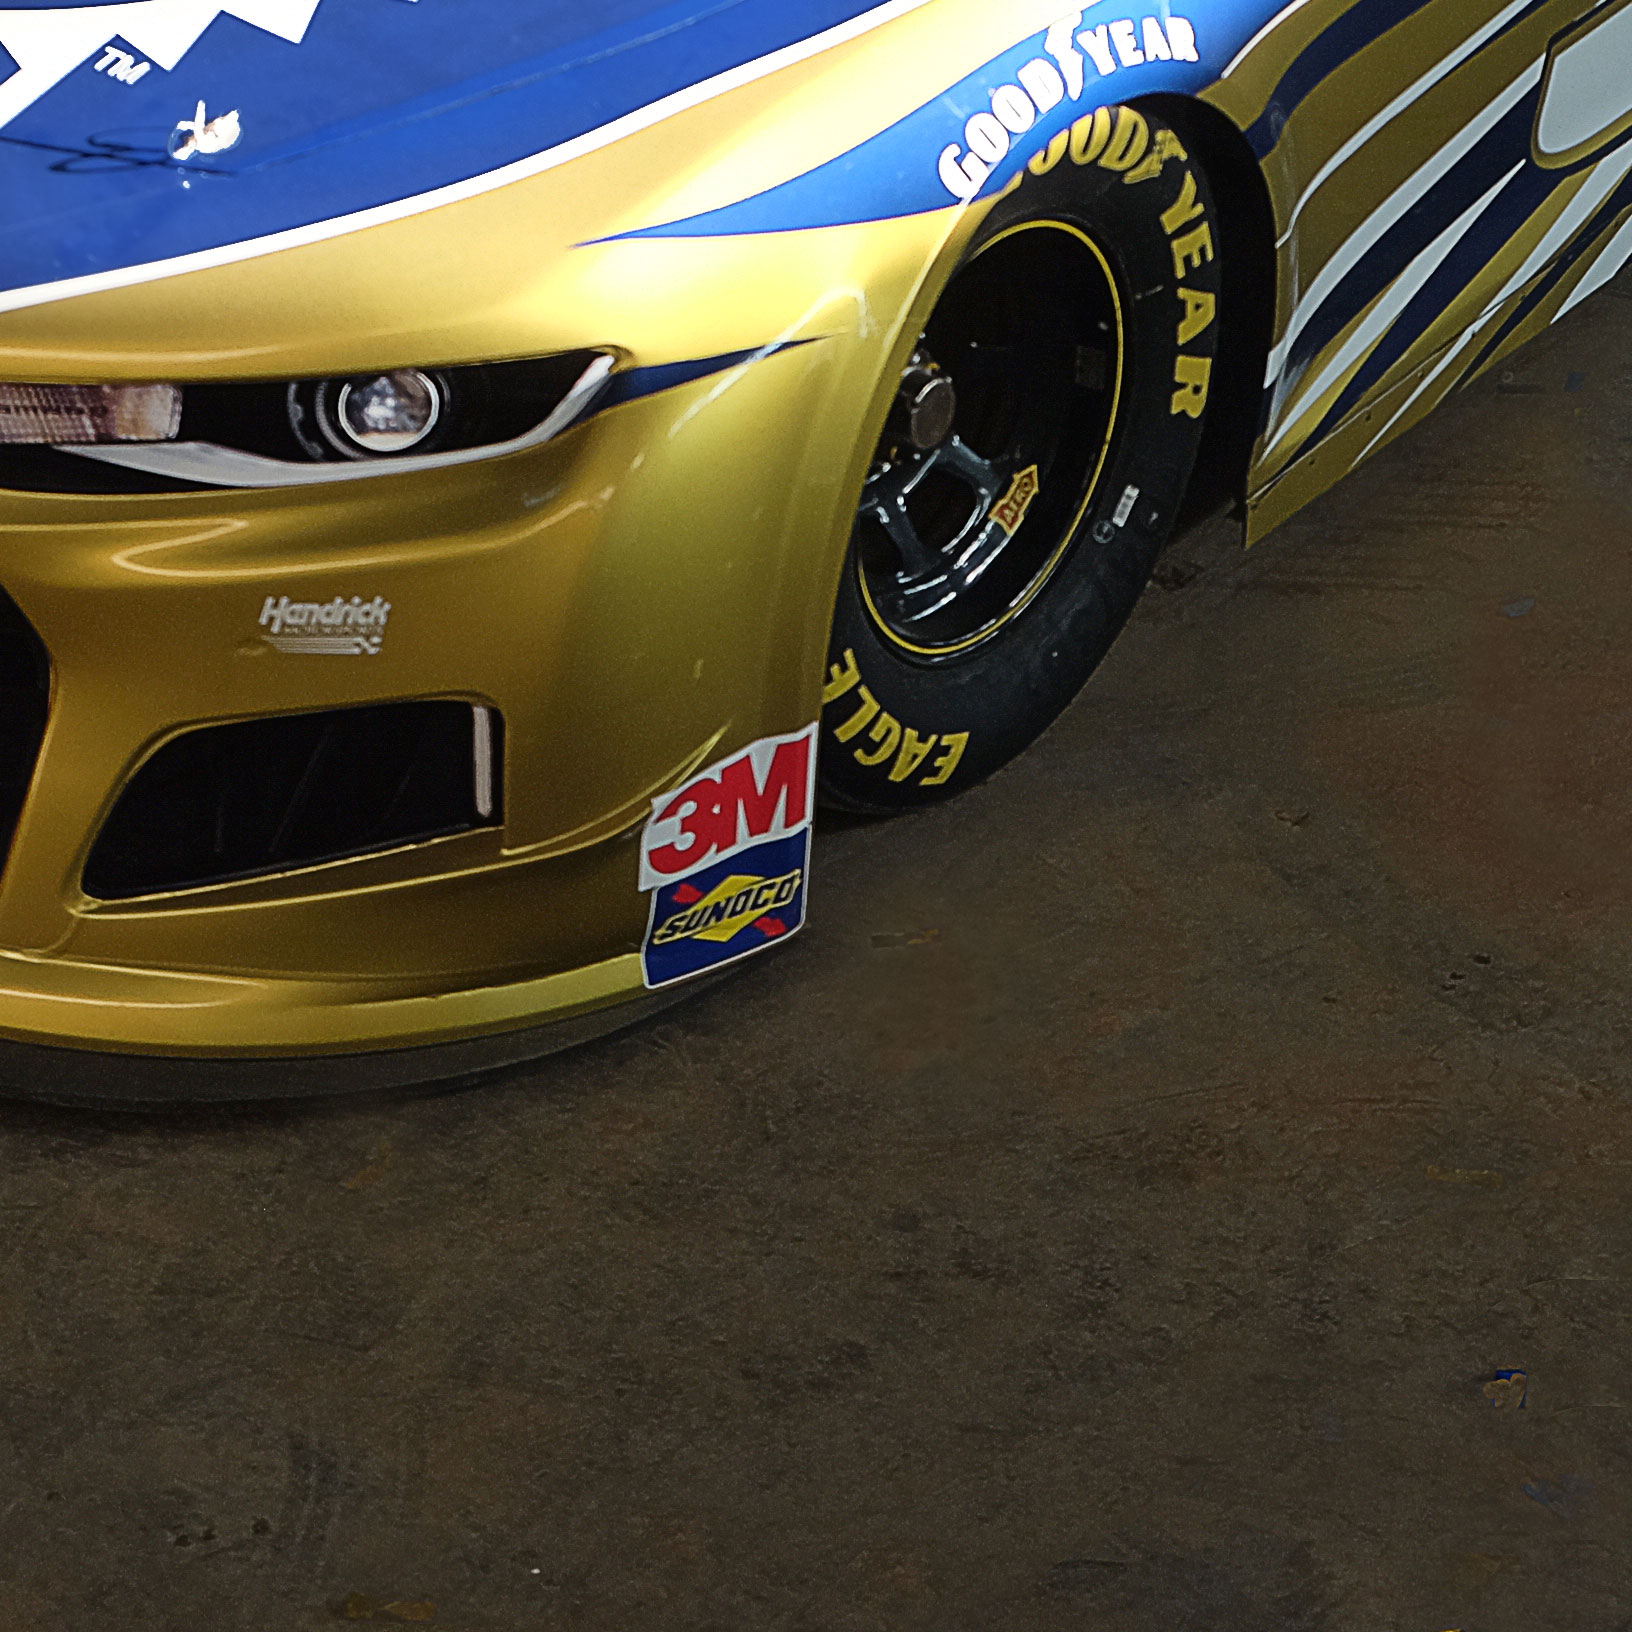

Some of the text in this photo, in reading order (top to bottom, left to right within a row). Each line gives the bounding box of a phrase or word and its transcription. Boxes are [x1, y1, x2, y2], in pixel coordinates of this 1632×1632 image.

[92, 44, 152, 86] TM
[258, 595, 393, 634] Hendrick
[820, 647, 970, 787] EAGLE
[648, 734, 811, 875] 3M
[654, 871, 800, 941] SUNOCO
